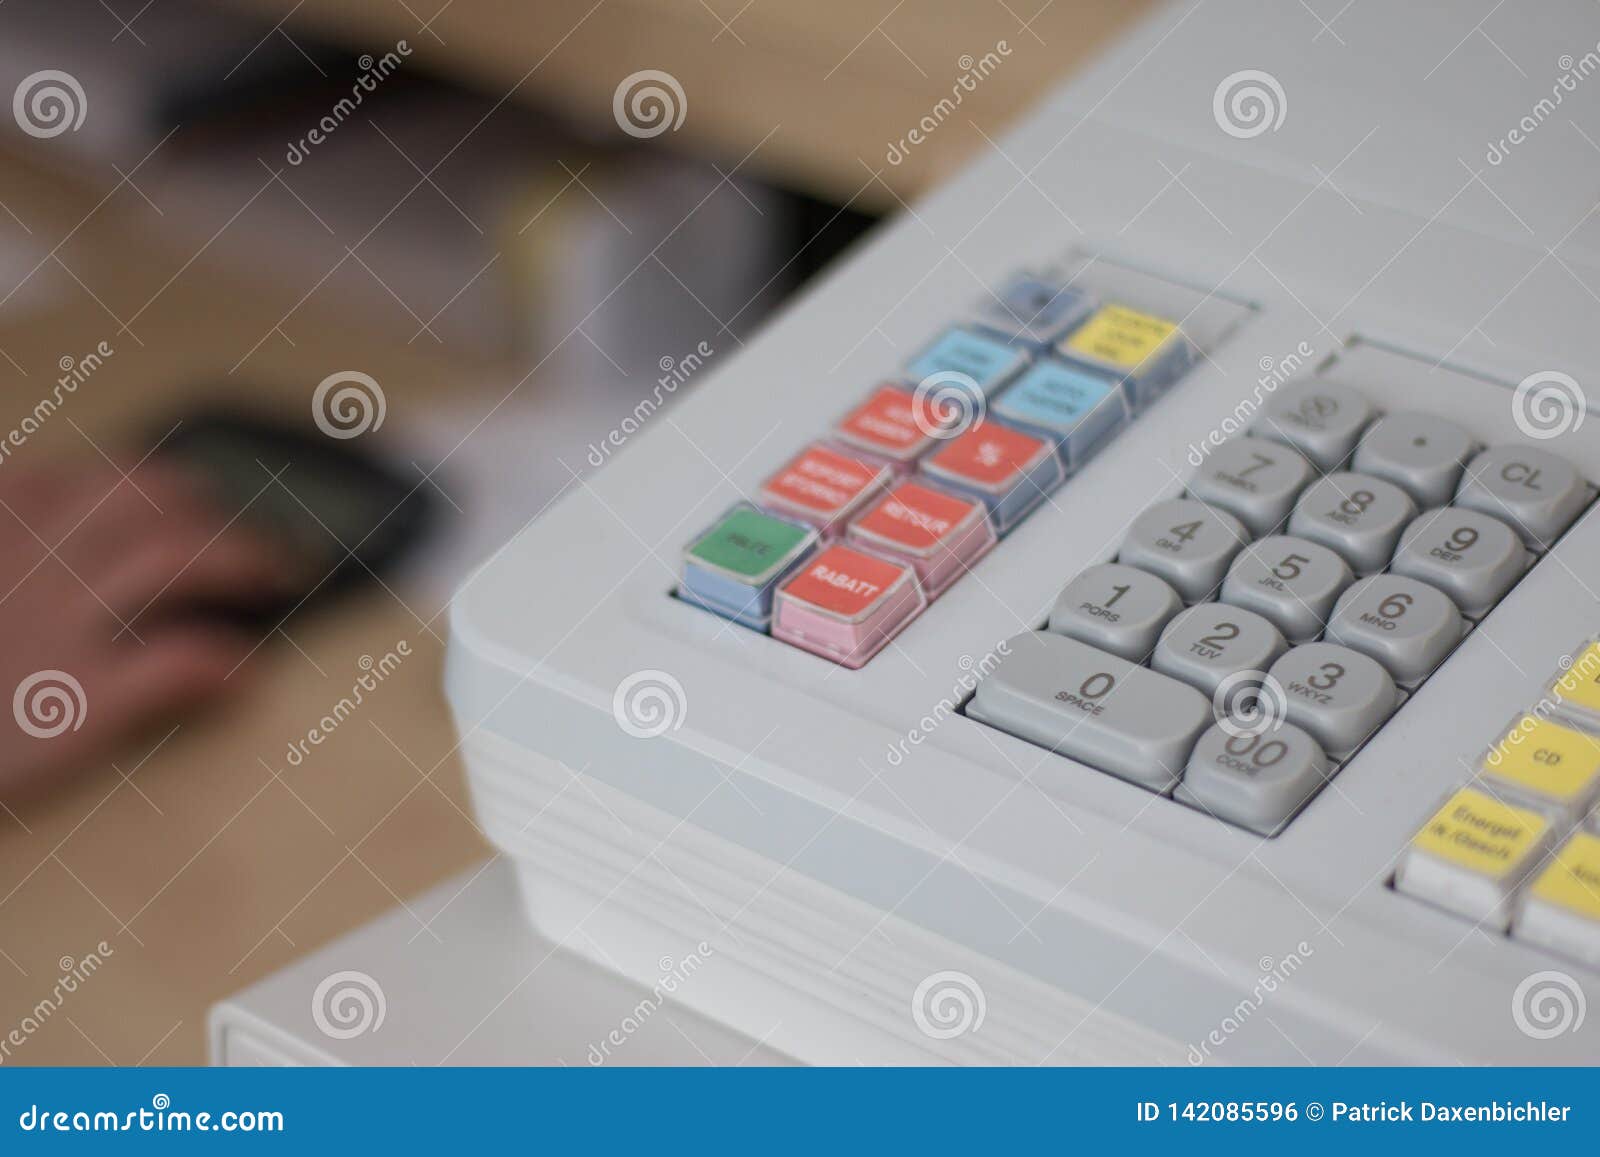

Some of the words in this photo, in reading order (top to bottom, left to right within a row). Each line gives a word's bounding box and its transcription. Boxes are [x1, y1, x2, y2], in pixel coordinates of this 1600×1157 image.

[1237, 453, 1275, 477] 7
[1501, 462, 1542, 490] CL
[1341, 490, 1376, 515] 8
[1169, 520, 1203, 543] 4
[1444, 526, 1479, 552] 9
[1272, 554, 1310, 580] 5
[1429, 547, 1463, 562] DEF
[810, 564, 879, 598] RABATT
[1258, 576, 1286, 592] JKL
[1103, 584, 1131, 608] 1
[1378, 593, 1414, 619] 6
[1079, 602, 1121, 623] PQRS
[1359, 612, 1397, 631] MNO
[1199, 622, 1241, 651] 2
[1188, 642, 1223, 660] TUV
[1079, 672, 1116, 700] 0
[1307, 662, 1346, 690] 3
[1054, 690, 1106, 716] SPACE
[1287, 680, 1334, 705] WXYZ
[1224, 730, 1290, 768] 00
[1533, 748, 1562, 766] CD
